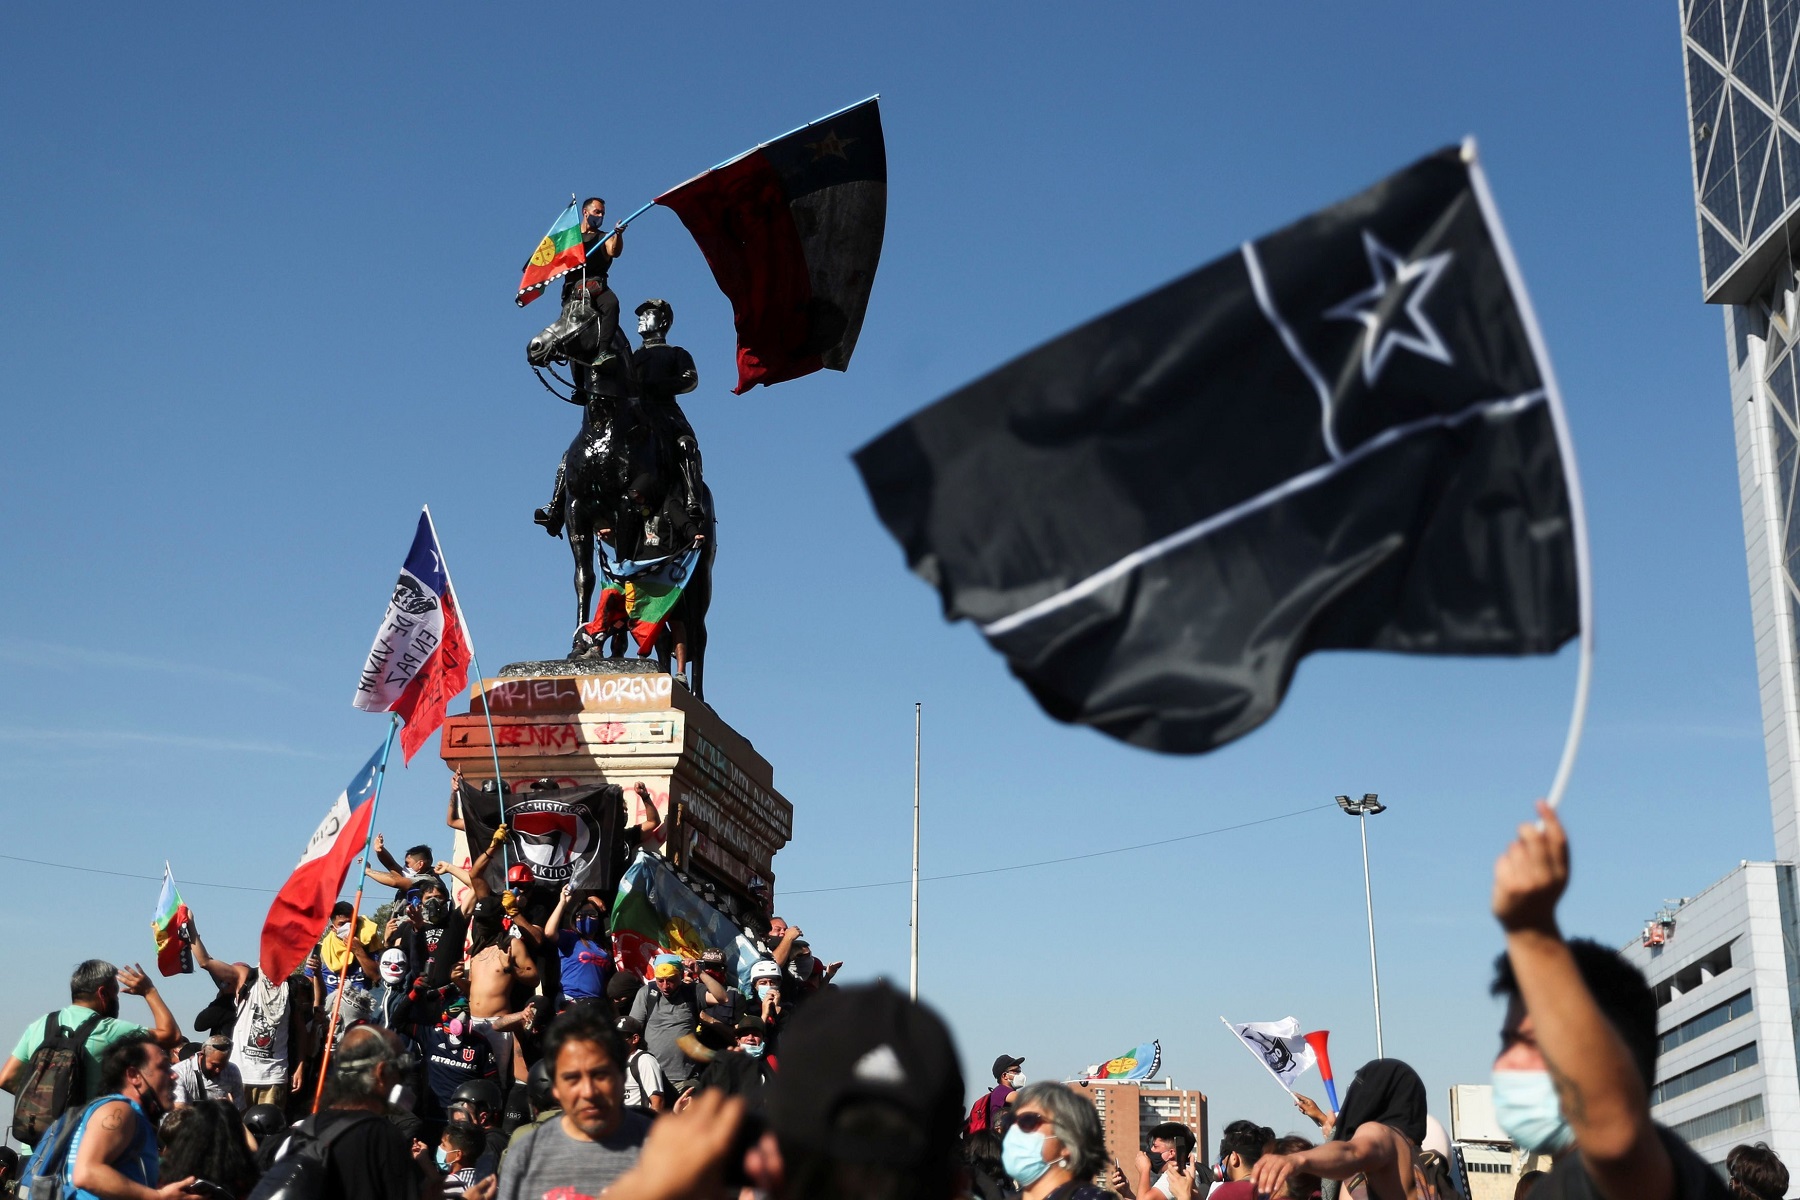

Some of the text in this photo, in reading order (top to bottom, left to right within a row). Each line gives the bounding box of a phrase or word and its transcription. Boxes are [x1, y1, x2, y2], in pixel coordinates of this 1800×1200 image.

[489, 676, 671, 708] ARIEL MORENO
[430, 1055, 478, 1070] PETROBRAS
